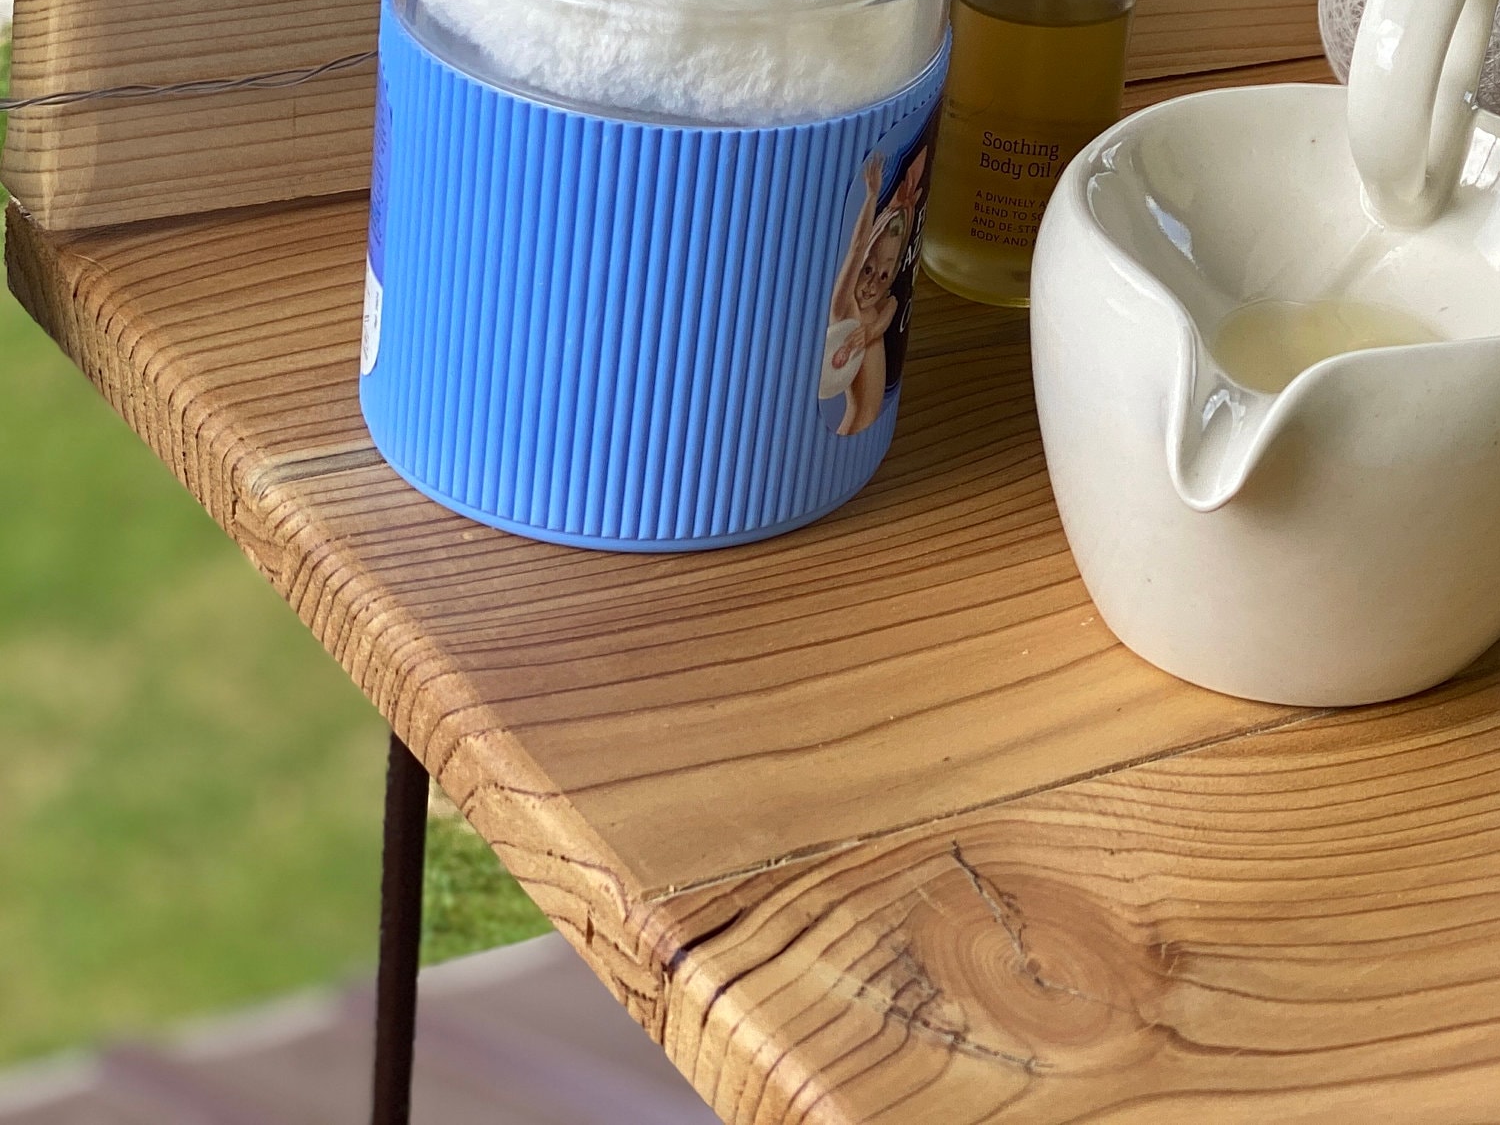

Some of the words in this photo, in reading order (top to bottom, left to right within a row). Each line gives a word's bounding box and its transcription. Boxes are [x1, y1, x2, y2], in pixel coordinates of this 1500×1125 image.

[982, 131, 1060, 161] Soothing
[980, 152, 1023, 180] Body
[1027, 161, 1051, 178] Oil
[975, 190, 983, 199] A
[985, 191, 1036, 209] DIVINELY
[974, 201, 1009, 219] BLEND
[1012, 210, 1028, 221] TO
[971, 215, 996, 229] AND
[970, 227, 1000, 244] BODY
[1003, 236, 1029, 248] AND
